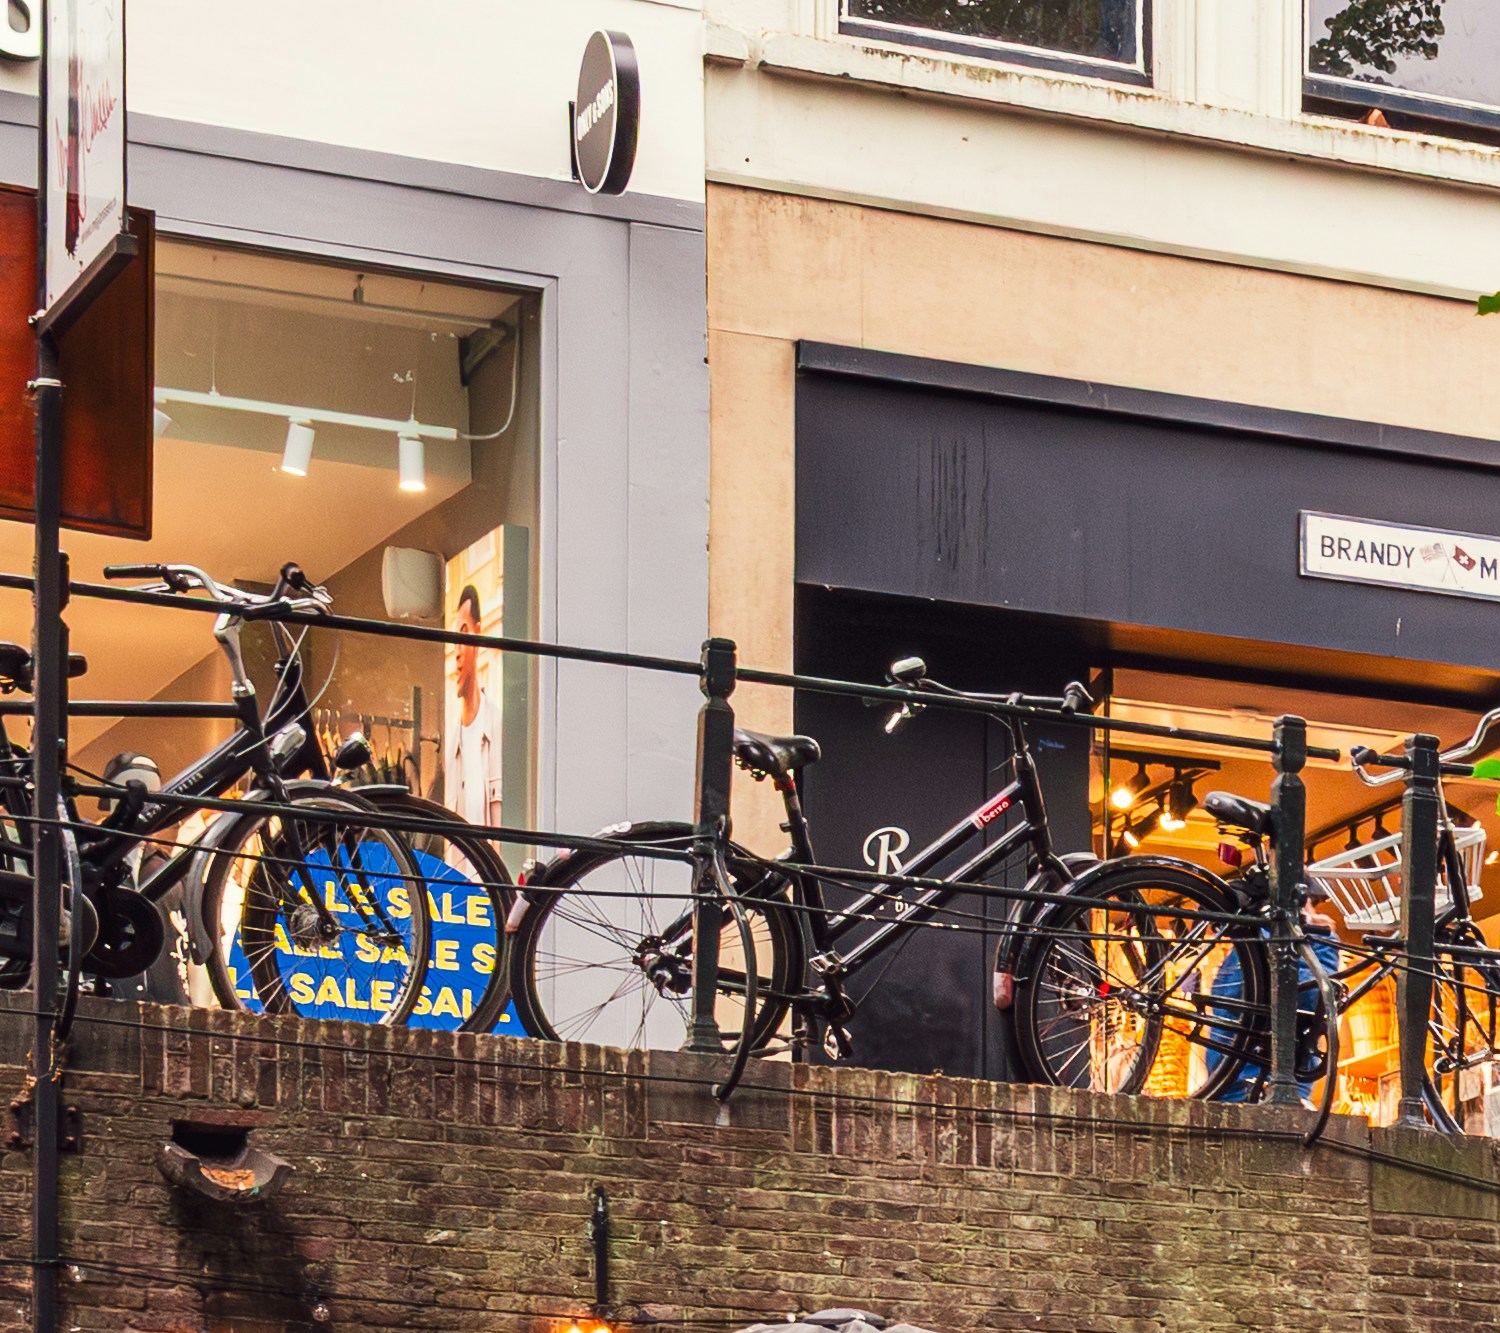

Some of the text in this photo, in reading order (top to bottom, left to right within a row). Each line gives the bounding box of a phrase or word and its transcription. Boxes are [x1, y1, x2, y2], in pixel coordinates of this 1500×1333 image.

[1320, 534, 1415, 569] BRANDY
[289, 972, 402, 1013] SALE
[413, 985, 512, 1024] SAL
